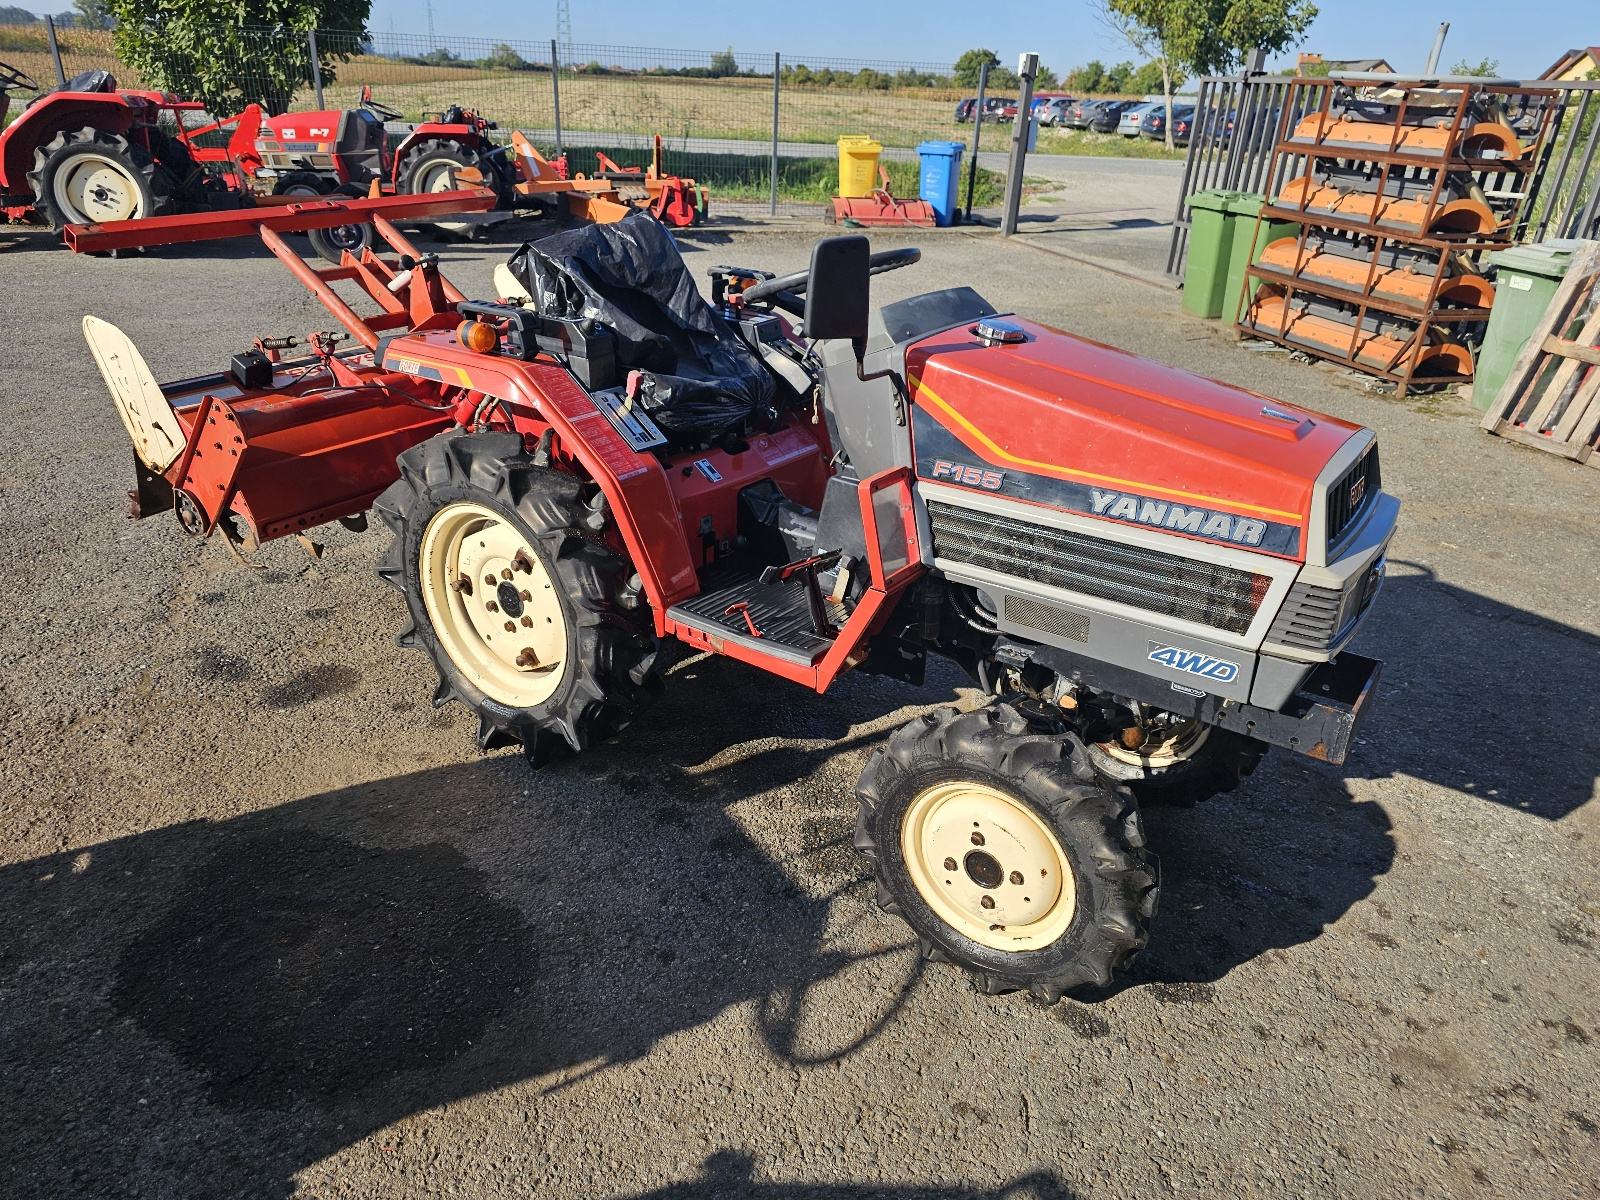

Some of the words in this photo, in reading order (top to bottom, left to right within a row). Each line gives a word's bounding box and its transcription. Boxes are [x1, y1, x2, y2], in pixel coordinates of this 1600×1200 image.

[932, 460, 1004, 490] F155
[1091, 489, 1267, 545] YANMAR
[1148, 646, 1239, 683] 4WD
